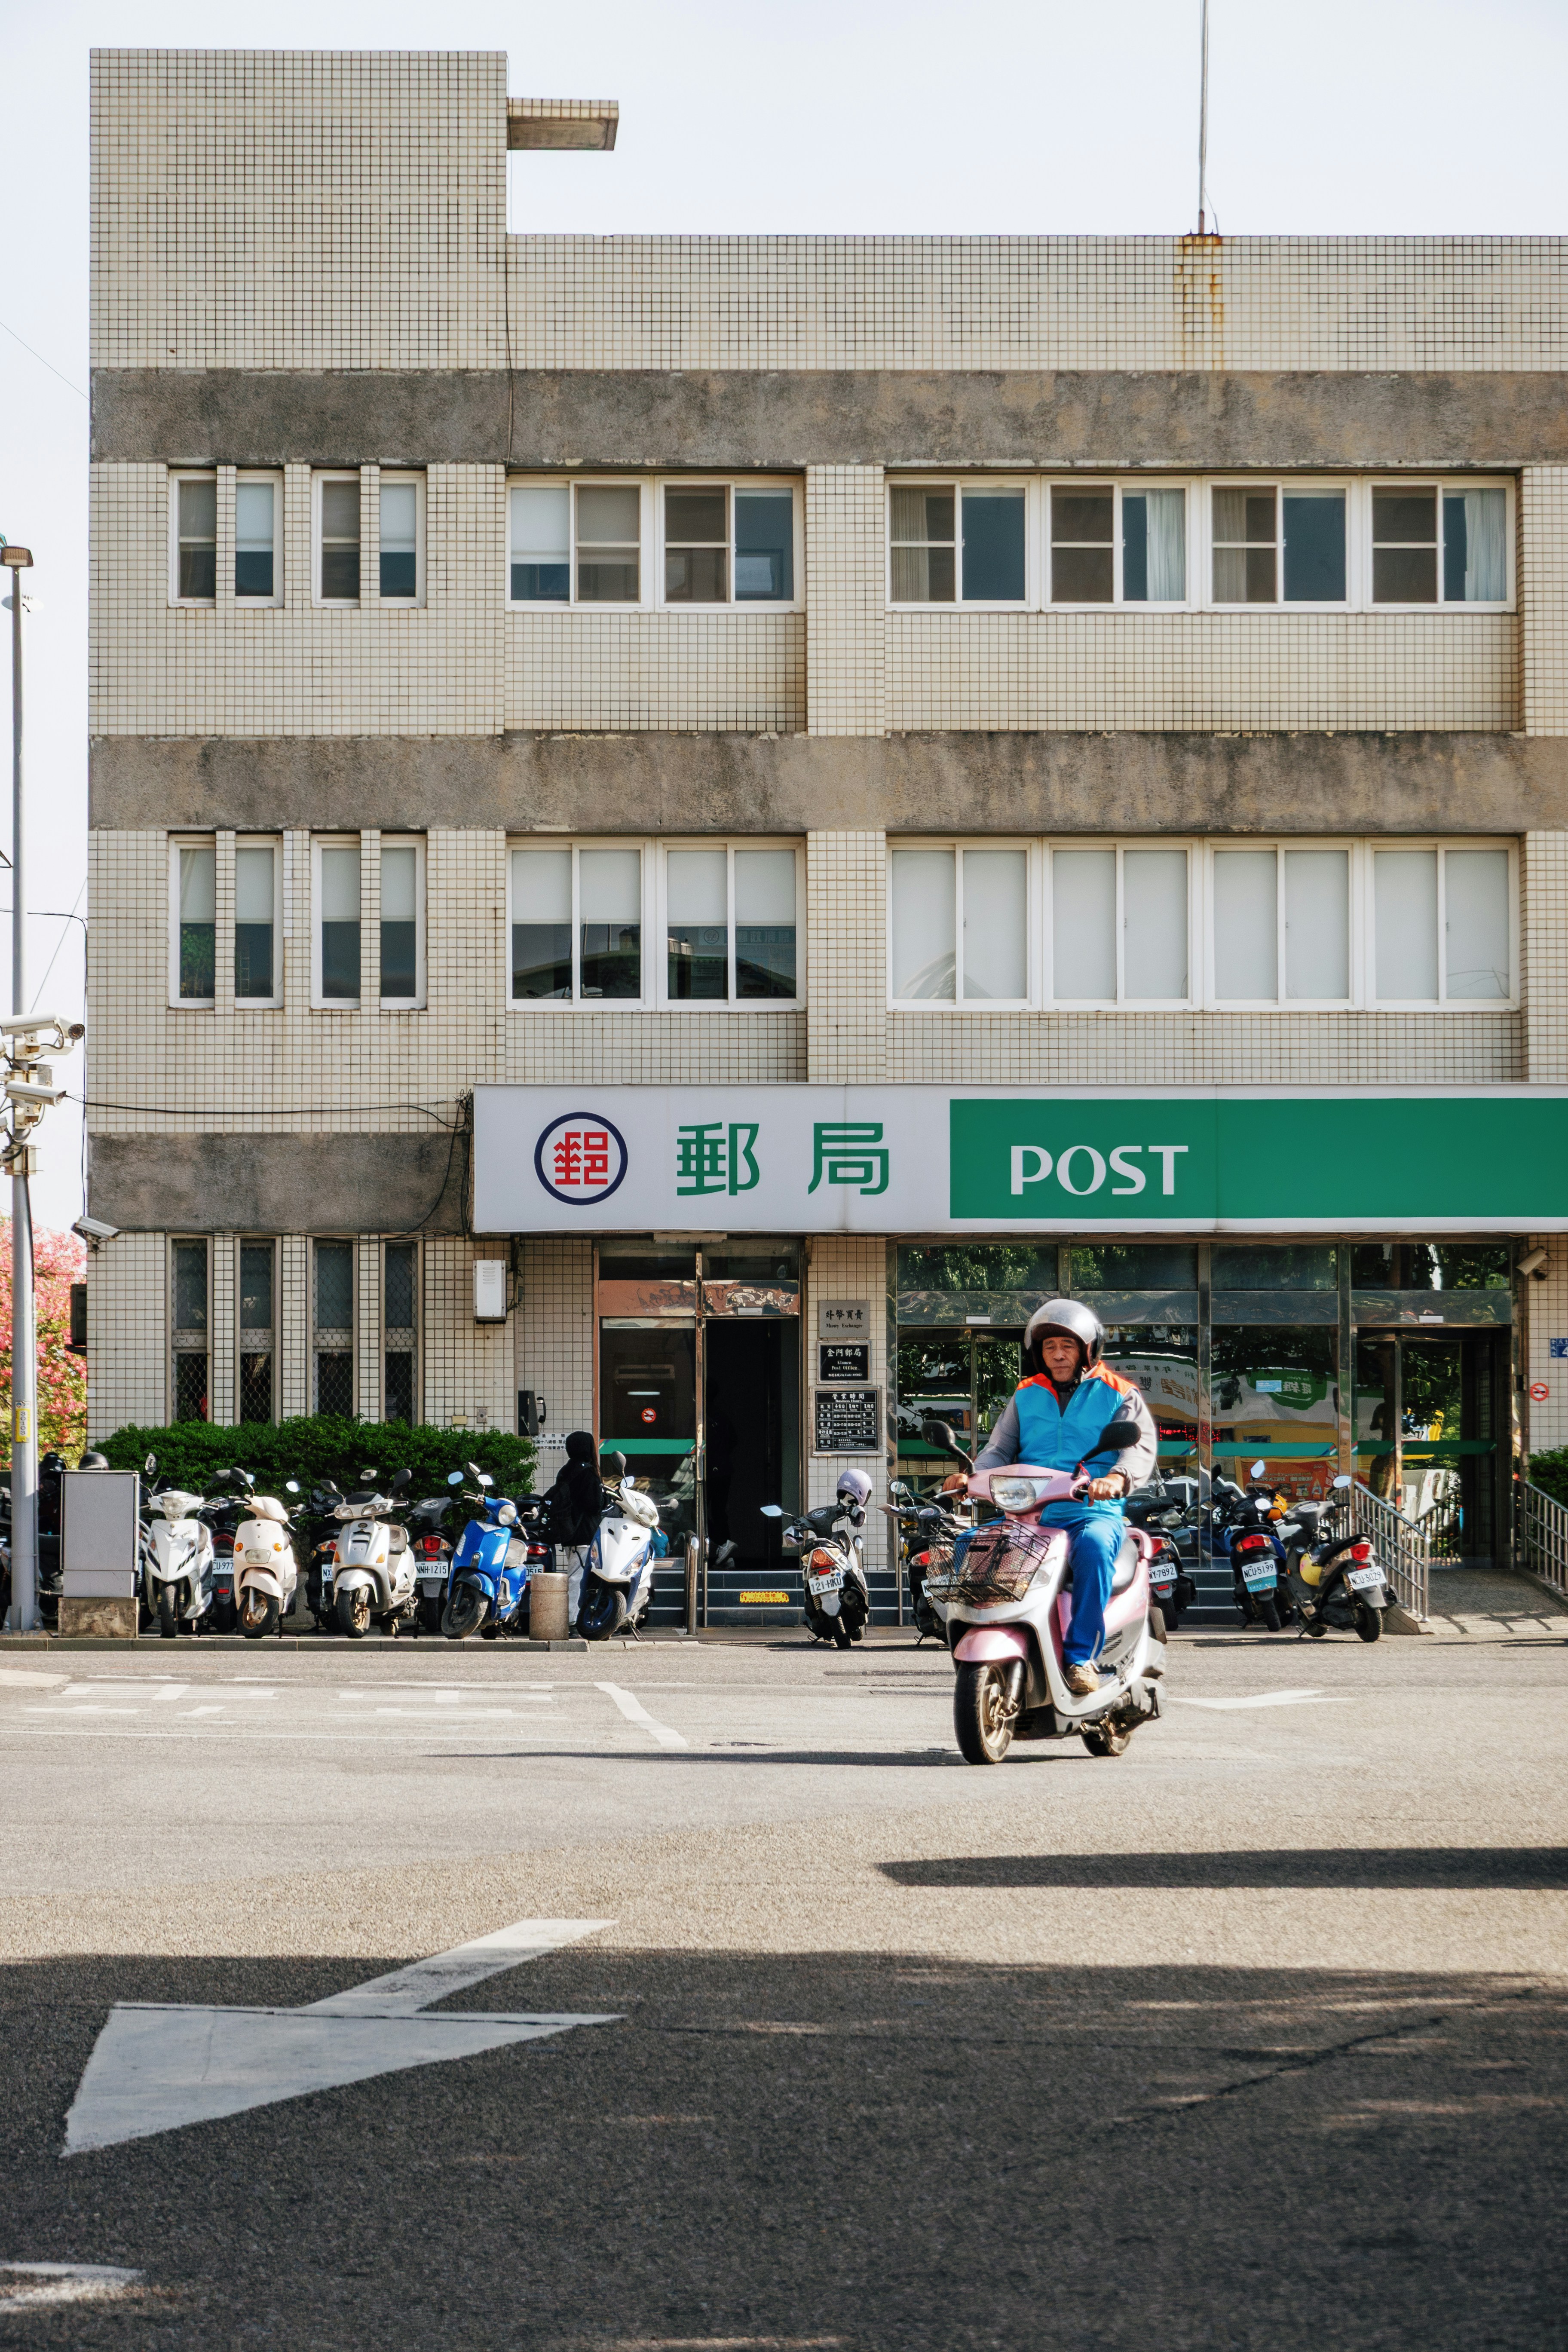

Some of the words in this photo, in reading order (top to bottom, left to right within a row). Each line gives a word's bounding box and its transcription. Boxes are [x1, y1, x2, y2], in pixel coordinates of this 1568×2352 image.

[676, 1121, 889, 1196] 郵局
[1011, 1145, 1188, 1195] POST
[827, 1348, 861, 1357] 金門郵局
[1243, 1564, 1273, 1578] NCU-5199
[1351, 1571, 1381, 1585] NCU-3029
[811, 1577, 842, 1592] 121-HKU
